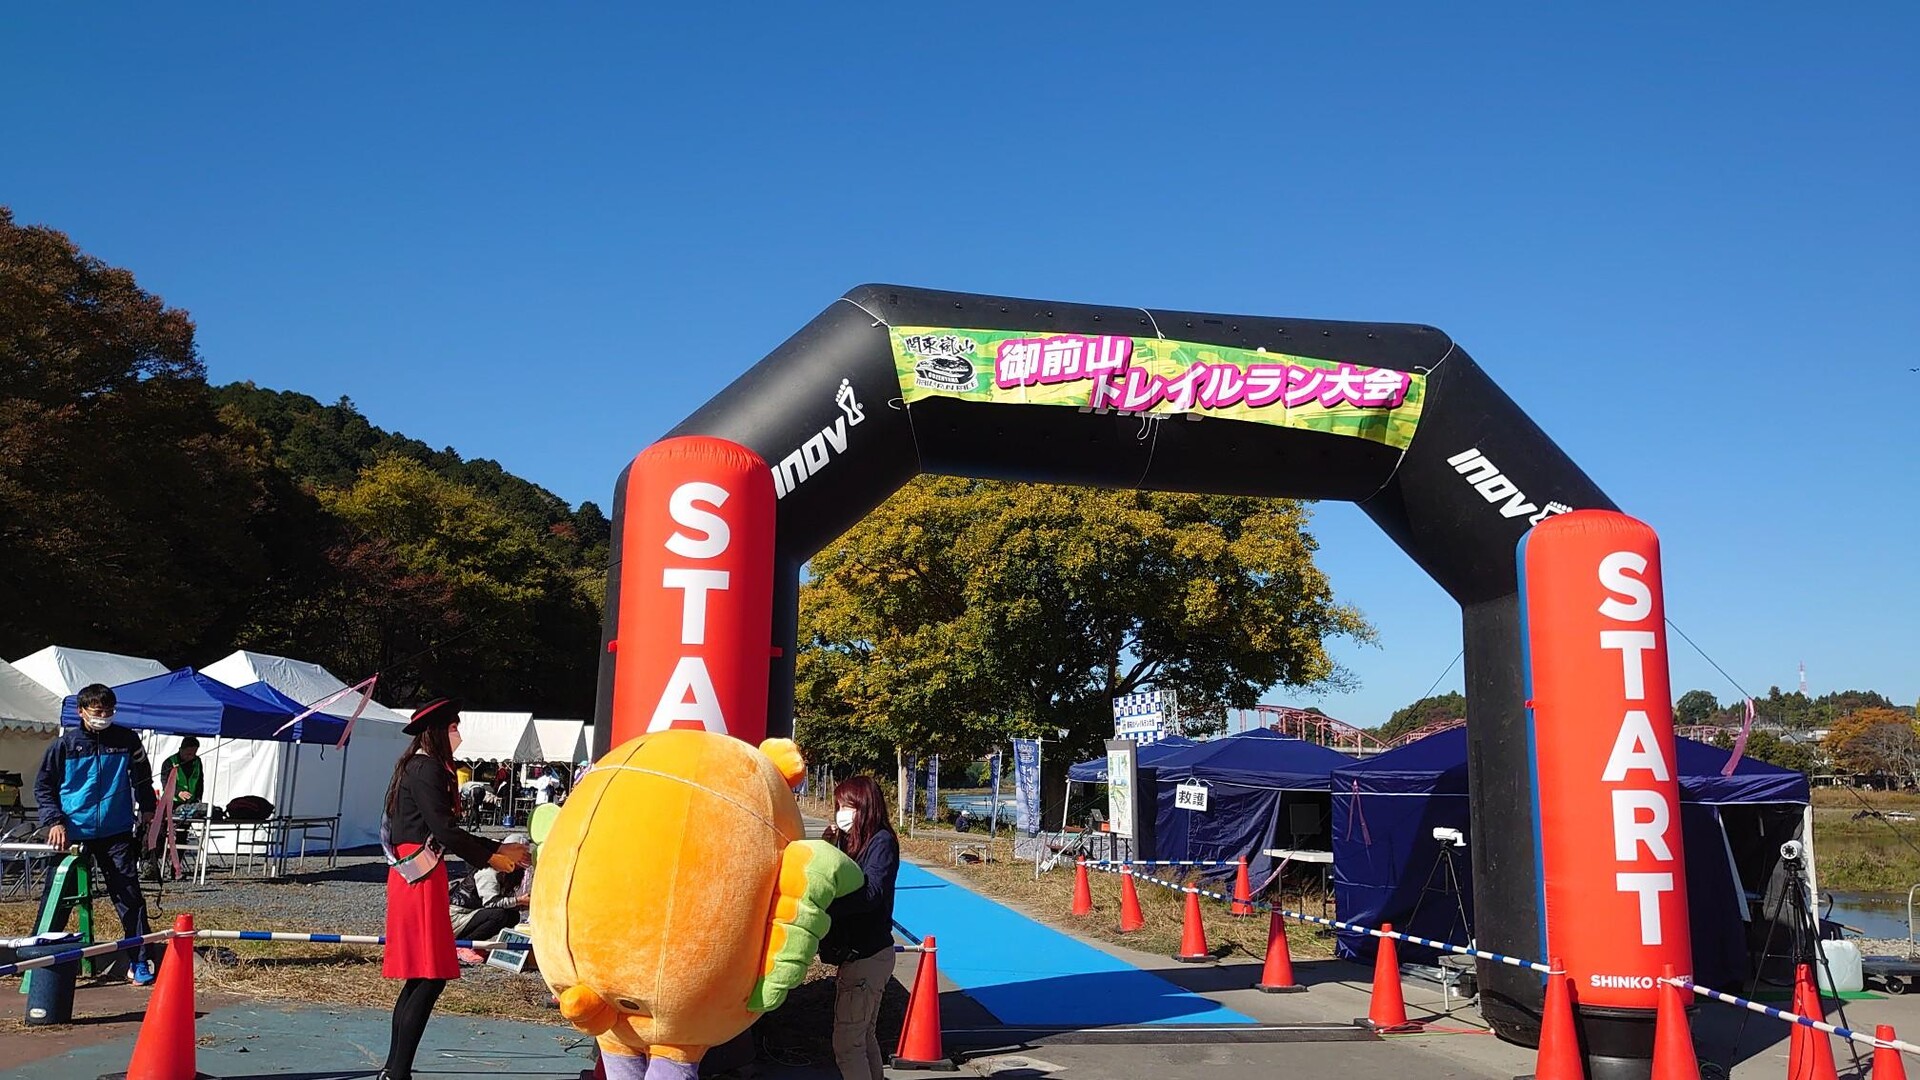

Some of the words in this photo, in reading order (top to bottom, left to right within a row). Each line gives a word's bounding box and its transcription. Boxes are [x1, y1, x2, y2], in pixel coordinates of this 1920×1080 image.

[998, 335, 1127, 383] 御前山
[1093, 367, 1403, 411] トレイルラン大会
[1598, 551, 1674, 946] START
[1178, 790, 1205, 806] 救護
[1590, 975, 1653, 989] SHINKO
